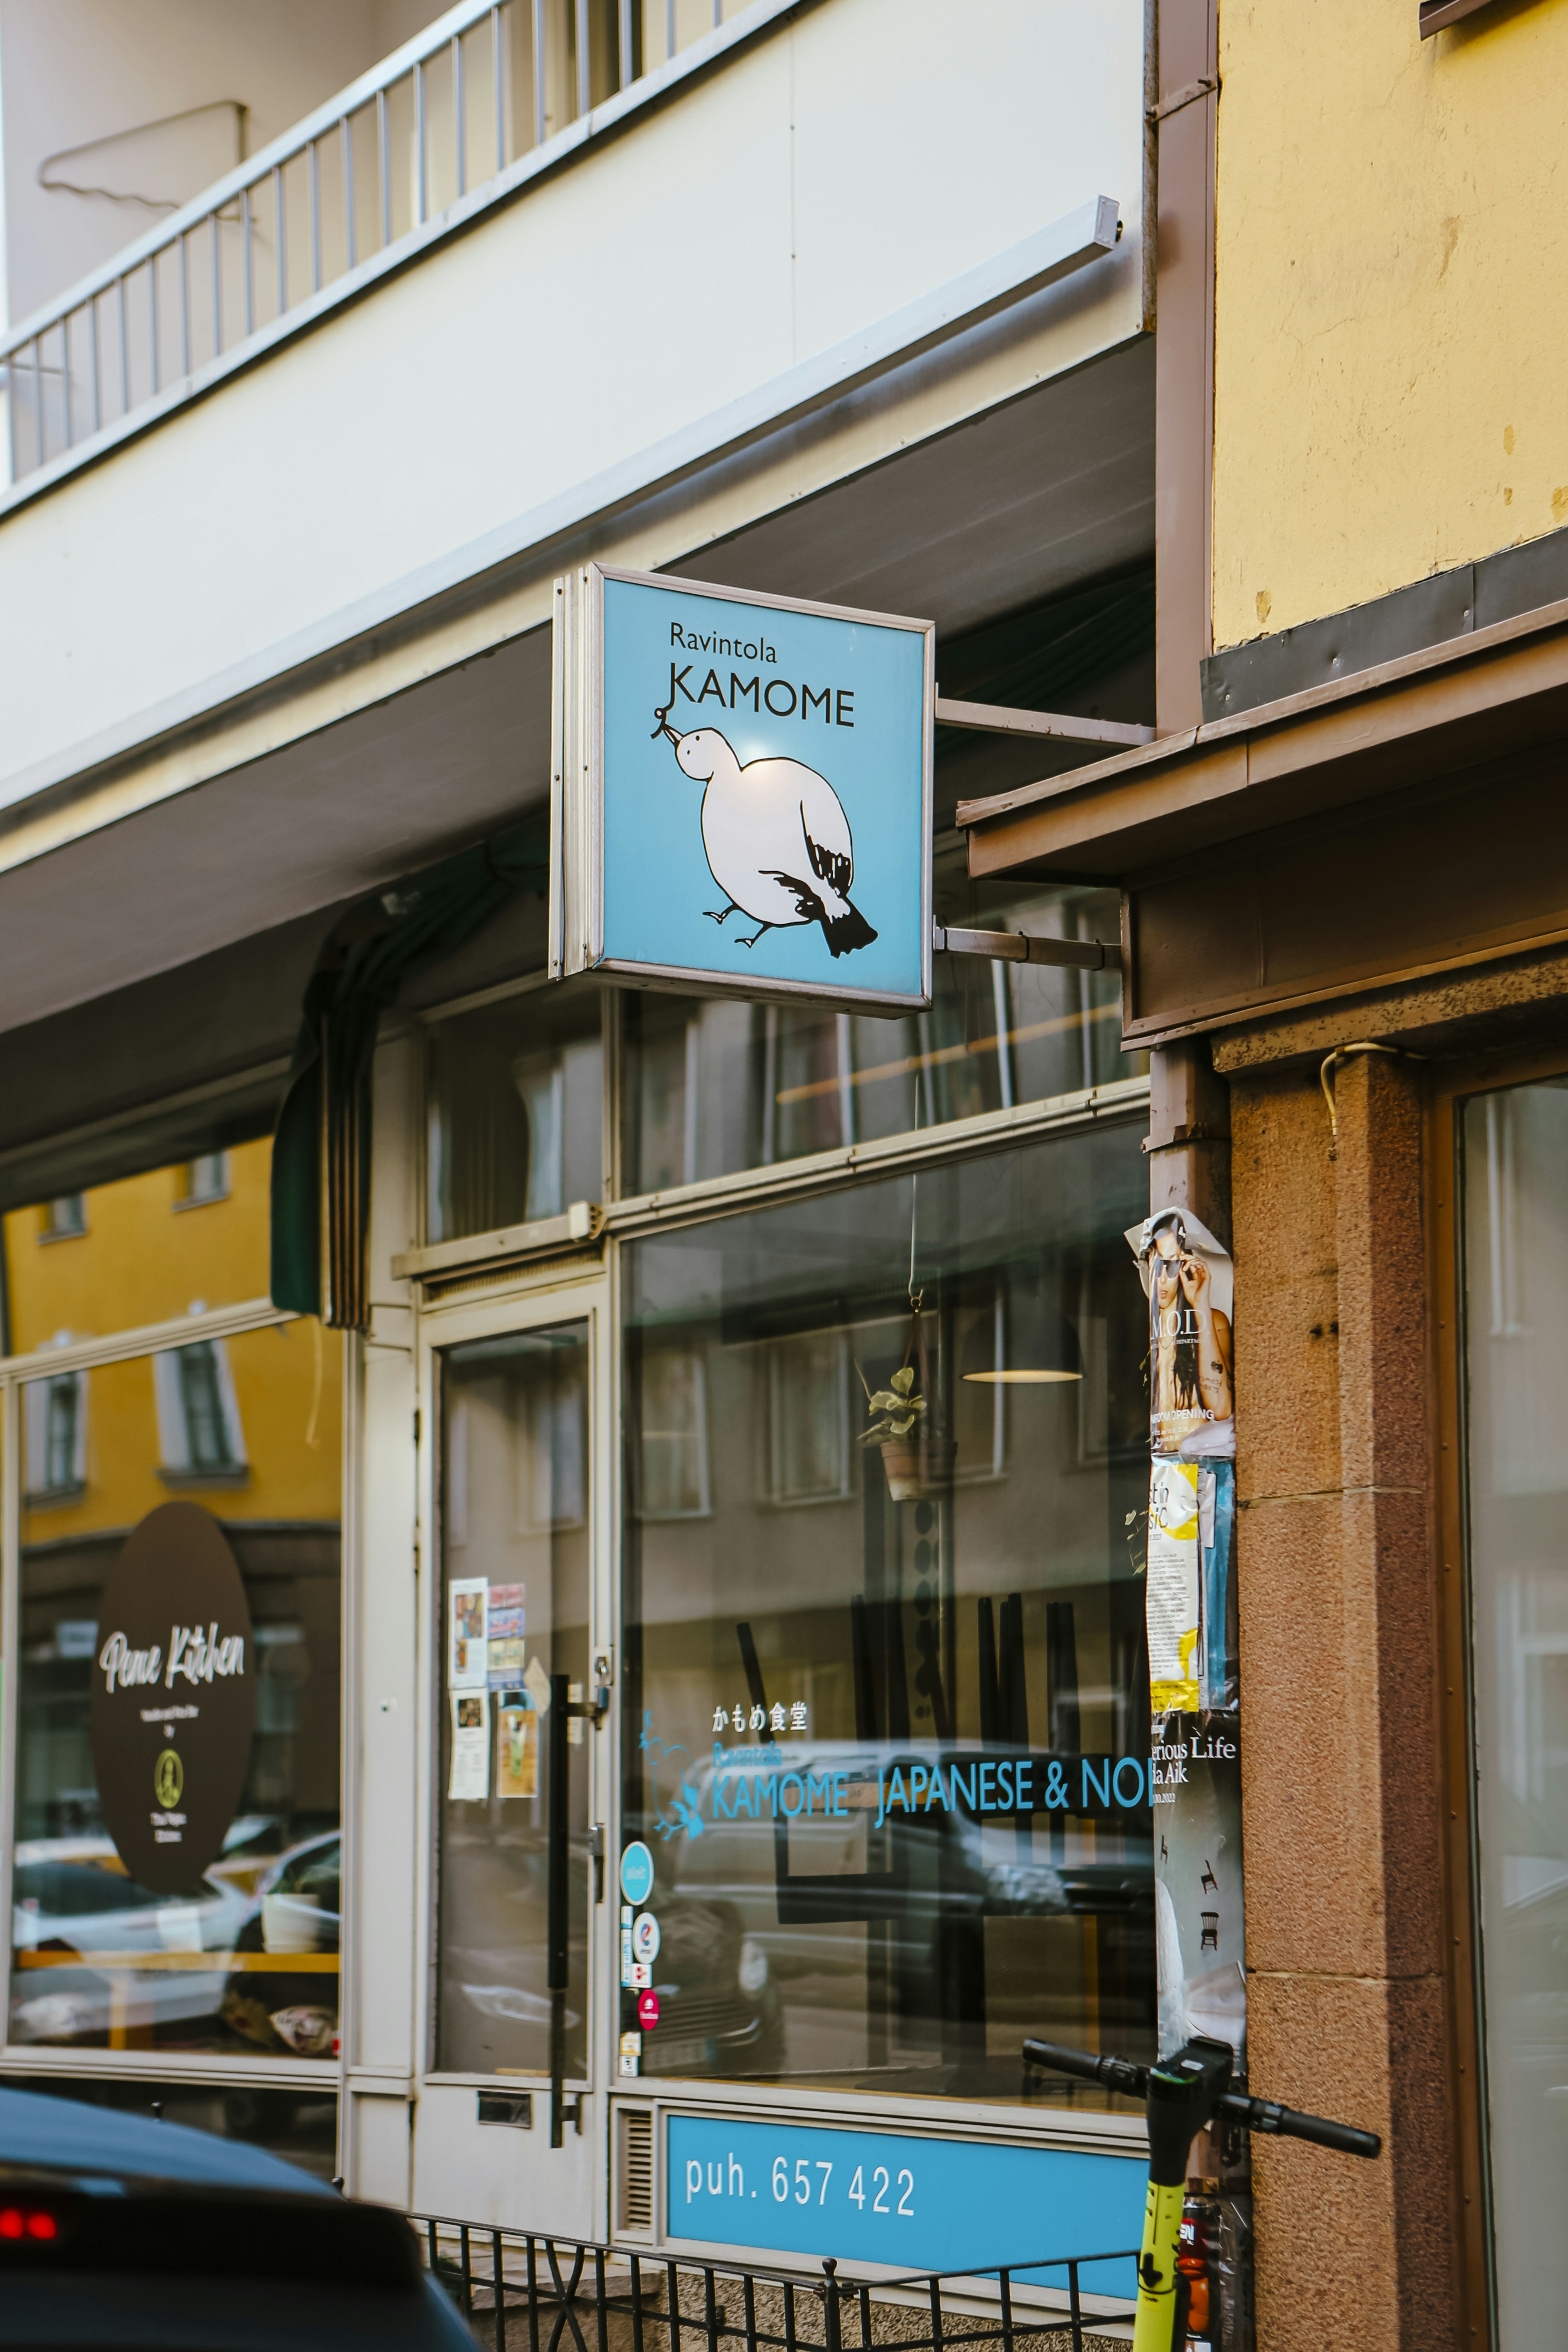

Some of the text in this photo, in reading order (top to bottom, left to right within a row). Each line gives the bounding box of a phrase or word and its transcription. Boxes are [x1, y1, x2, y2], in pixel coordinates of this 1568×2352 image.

[671, 622, 777, 664] Ravintola
[667, 662, 855, 727] KAMOME
[1171, 1409, 1215, 1420] OPENING
[1160, 1482, 1169, 1504] in
[165, 1622, 244, 1689] Kitchen
[712, 1701, 808, 1732] かもめ食堂
[713, 1740, 782, 1767] Ravintola
[1190, 1736, 1237, 1759] Life
[1164, 1761, 1189, 1784] Aik
[713, 1757, 1154, 1829] KAMOME JAPANESE & NO
[686, 2152, 914, 2216] puh. 657 422
